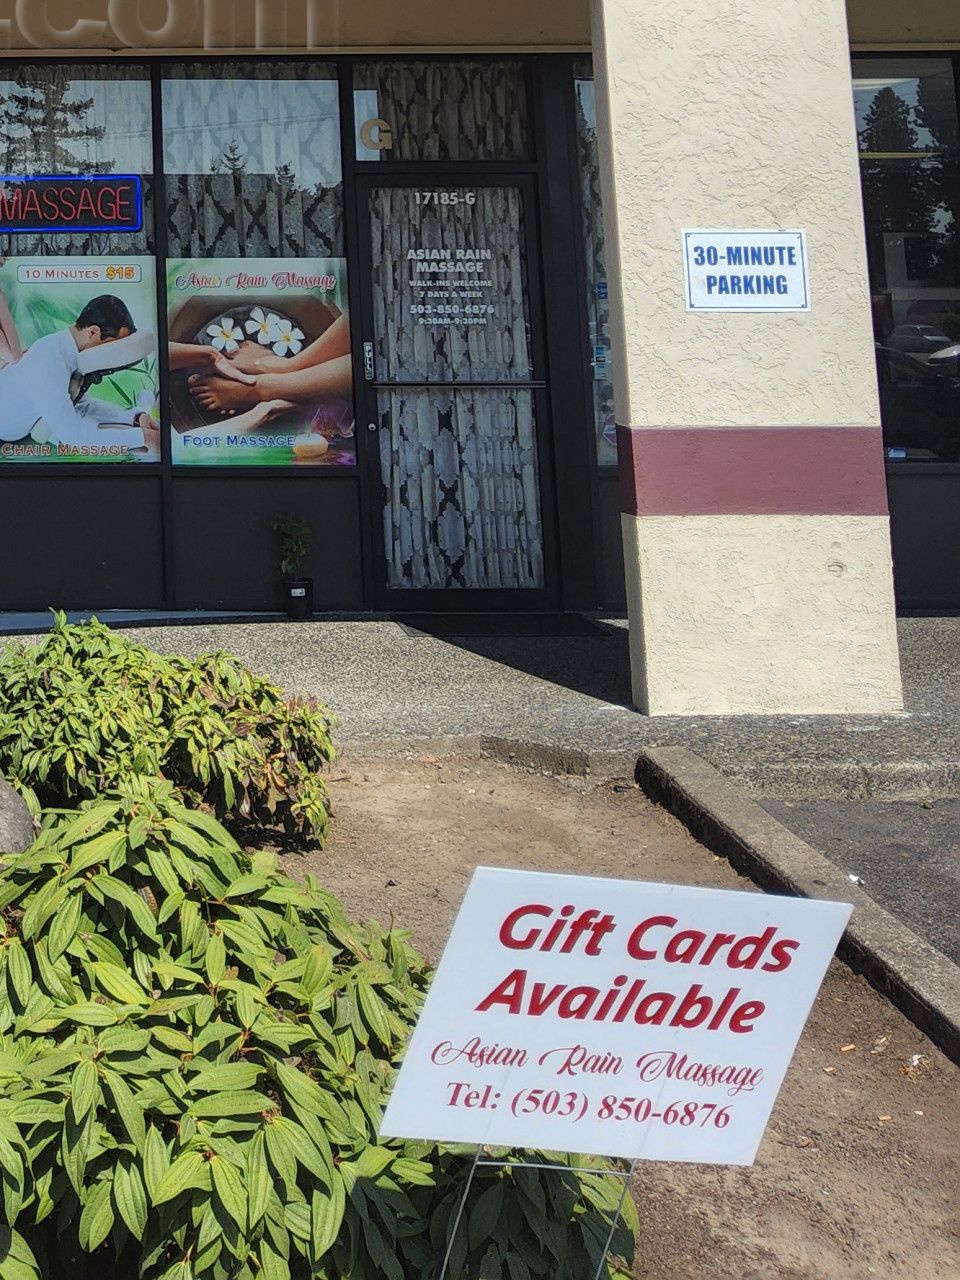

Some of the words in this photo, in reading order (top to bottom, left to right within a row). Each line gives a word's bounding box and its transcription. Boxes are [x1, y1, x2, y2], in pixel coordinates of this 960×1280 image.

[361, 119, 392, 150] G
[414, 192, 476, 205] 17185-G
[407, 249, 451, 260] ASIAN
[455, 249, 492, 260] RAIN
[693, 245, 797, 266] 30-MINUTE
[25, 270, 40, 279] 10
[105, 265, 136, 281] $15
[416, 262, 484, 273] MASSAGE
[225, 272, 268, 289] Rain
[272, 271, 338, 293] Massage
[706, 274, 788, 295] PARKING
[409, 304, 495, 314] 503-850-6876
[56, 442, 130, 457] MASSAGE
[182, 434, 221, 448] FOOT
[225, 434, 296, 448] MASSAGE
[499, 903, 617, 957] Gift
[626, 914, 801, 973] Cards
[474, 968, 766, 1033] Available
[430, 1037, 528, 1068] Asian
[538, 1044, 624, 1076] Rain
[636, 1051, 764, 1097] Massage
[446, 1081, 502, 1110] Tel:
[510, 1088, 589, 1123] (503)
[597, 1094, 733, 1130] 850-6876
